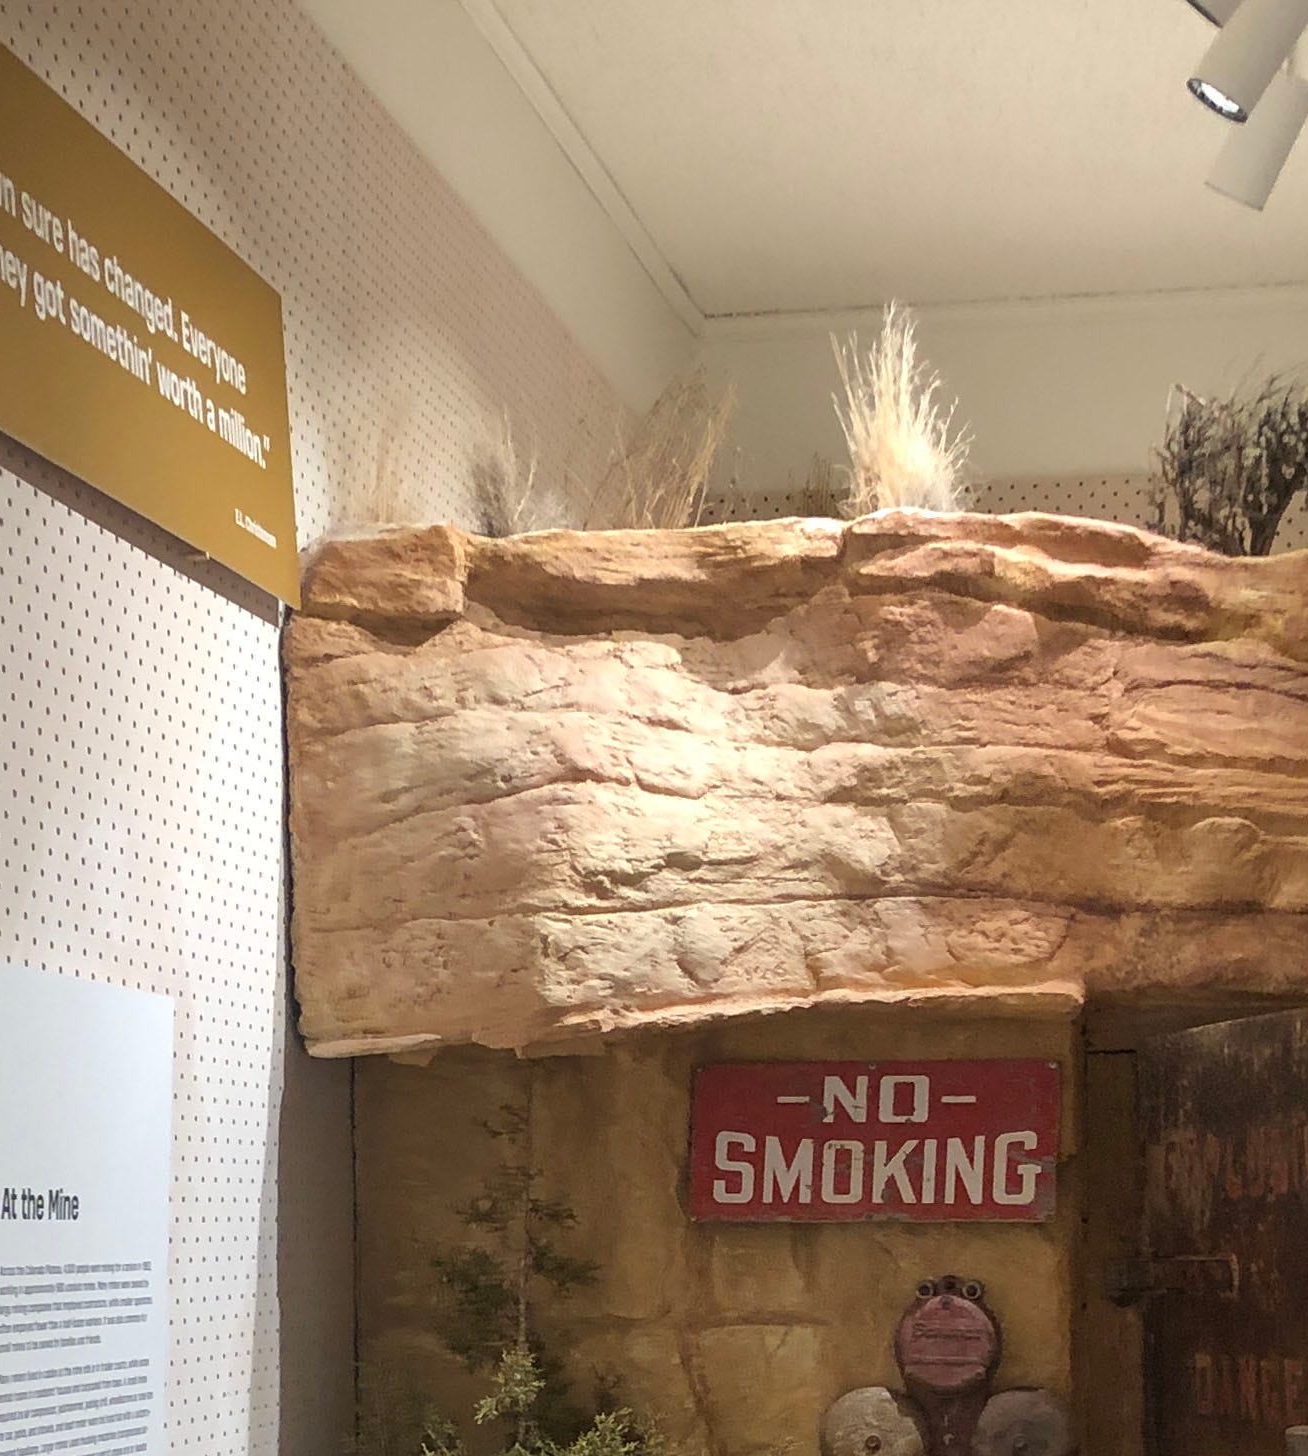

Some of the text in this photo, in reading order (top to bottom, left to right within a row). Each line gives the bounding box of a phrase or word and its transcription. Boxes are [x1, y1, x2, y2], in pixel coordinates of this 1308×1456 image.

[21, 192, 64, 254] sure
[68, 218, 100, 282] has
[104, 256, 178, 342] changed.
[181, 309, 246, 395] Everyone
[33, 271, 66, 326] got
[70, 298, 152, 386] somethin'
[156, 362, 203, 424] worth
[206, 398, 215, 432] a
[218, 407, 270, 470] million."
[1, 1187, 79, 1220] At the Mine
[713, 1130, 1042, 1205] SMOKING
